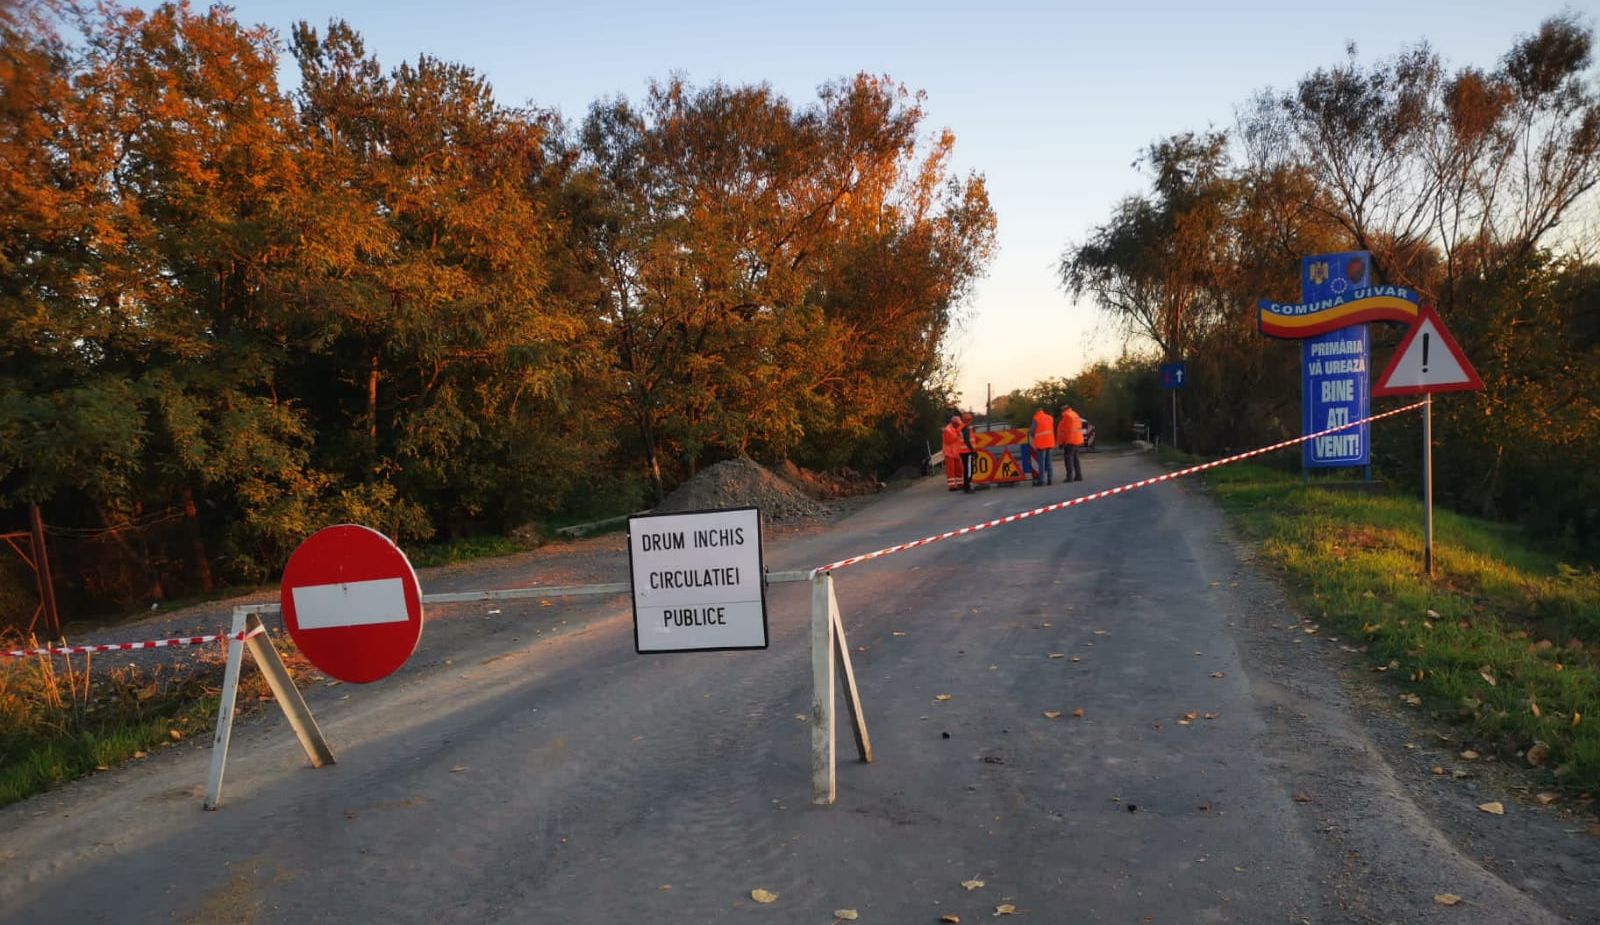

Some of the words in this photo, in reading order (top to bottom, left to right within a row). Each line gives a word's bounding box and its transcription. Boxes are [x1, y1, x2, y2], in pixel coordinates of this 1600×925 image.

[1271, 296, 1344, 315] COMUNA
[1354, 286, 1408, 299] UIVAR
[1321, 379, 1354, 403] BINE
[1315, 434, 1360, 458] VENIT!
[642, 532, 685, 552] DRUM
[694, 528, 744, 548] INCHIS
[650, 566, 740, 589] CIRCULATIEI
[663, 607, 727, 627] PUBLICE
